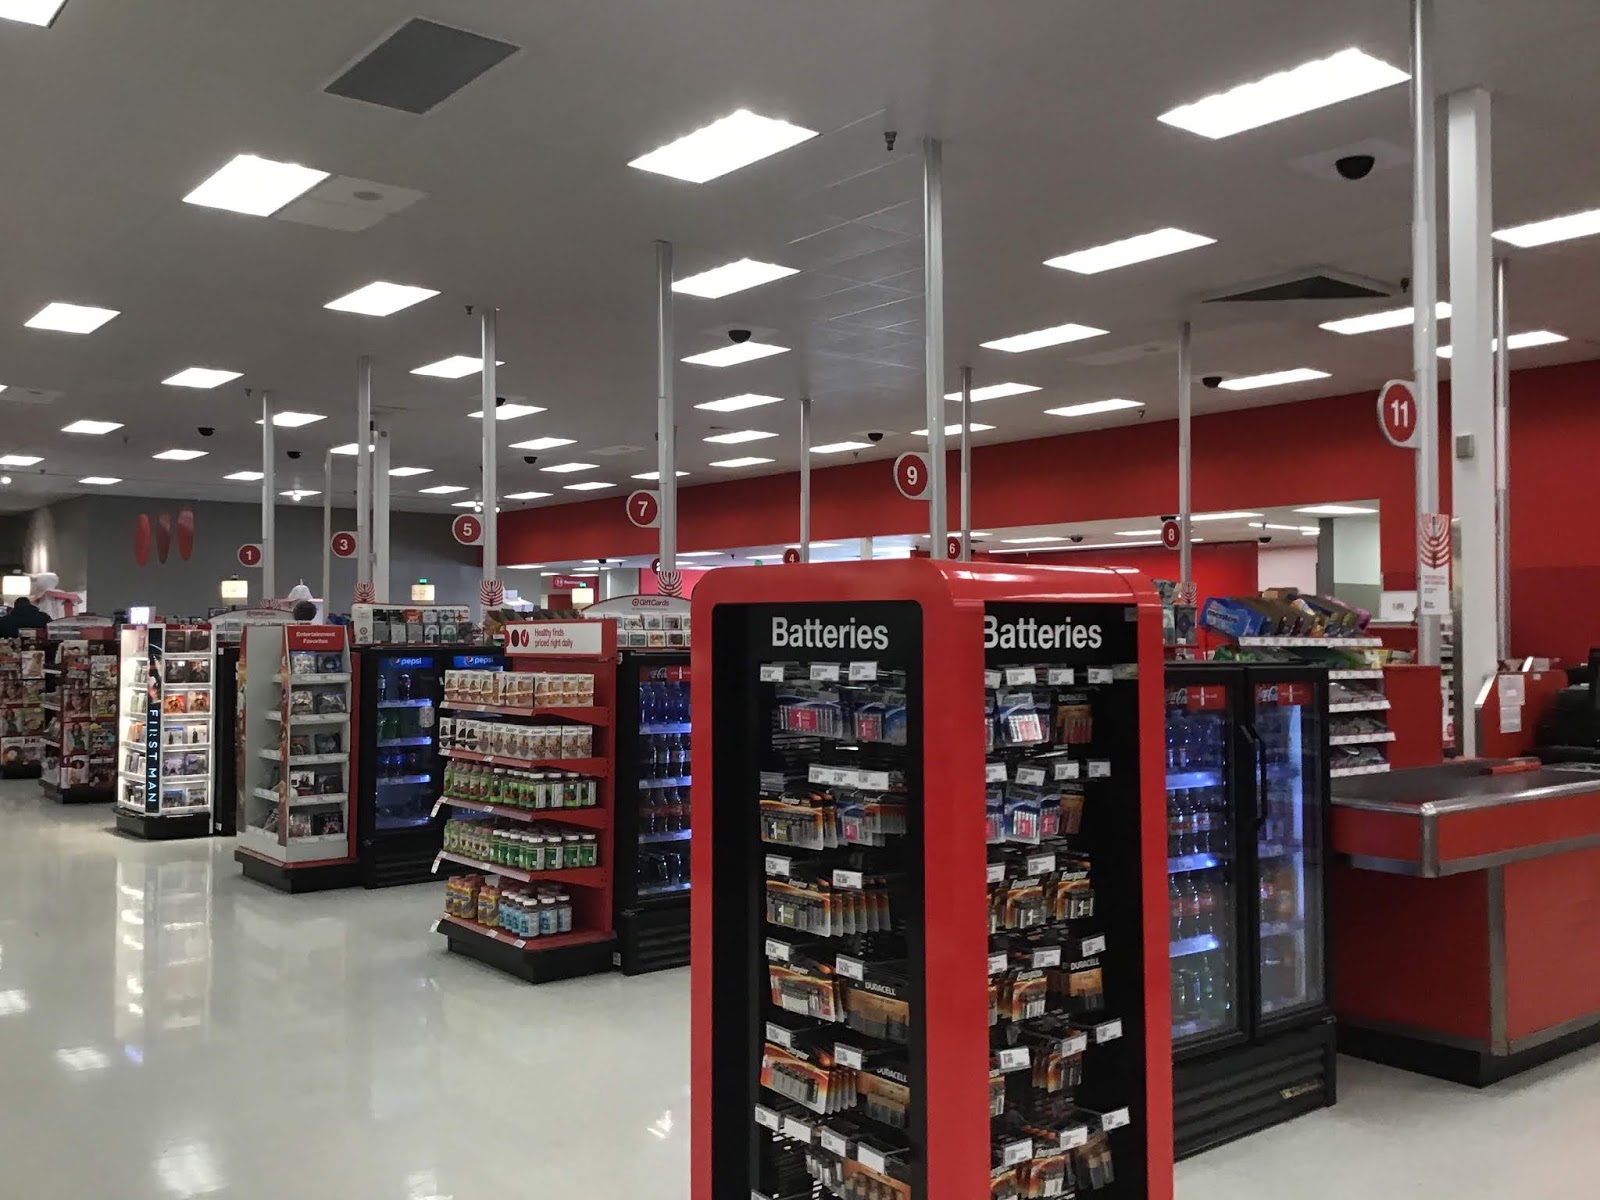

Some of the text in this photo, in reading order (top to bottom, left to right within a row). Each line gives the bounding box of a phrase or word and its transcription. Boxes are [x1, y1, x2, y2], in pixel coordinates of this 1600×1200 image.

[1391, 399, 1409, 428] 11
[907, 466, 918, 486] 9
[638, 500, 648, 516] 7
[462, 523, 472, 536] 5
[1168, 528, 1175, 541] 8
[340, 539, 348, 550] 3
[950, 542, 956, 554] 6
[246, 550, 252, 560] 1
[788, 554, 794, 563] 4
[534, 628, 564, 638] Healthy finds
[772, 616, 890, 650] Batteries
[984, 615, 1102, 649] Batteries
[534, 639, 574, 648] priced right daily
[402, 658, 422, 666] pepsi
[474, 656, 494, 664] pepsi
[148, 709, 158, 760] FIRST
[148, 768, 157, 802] MAN
[1070, 958, 1100, 970] DURACELL
[864, 981, 896, 996] DURACELL
